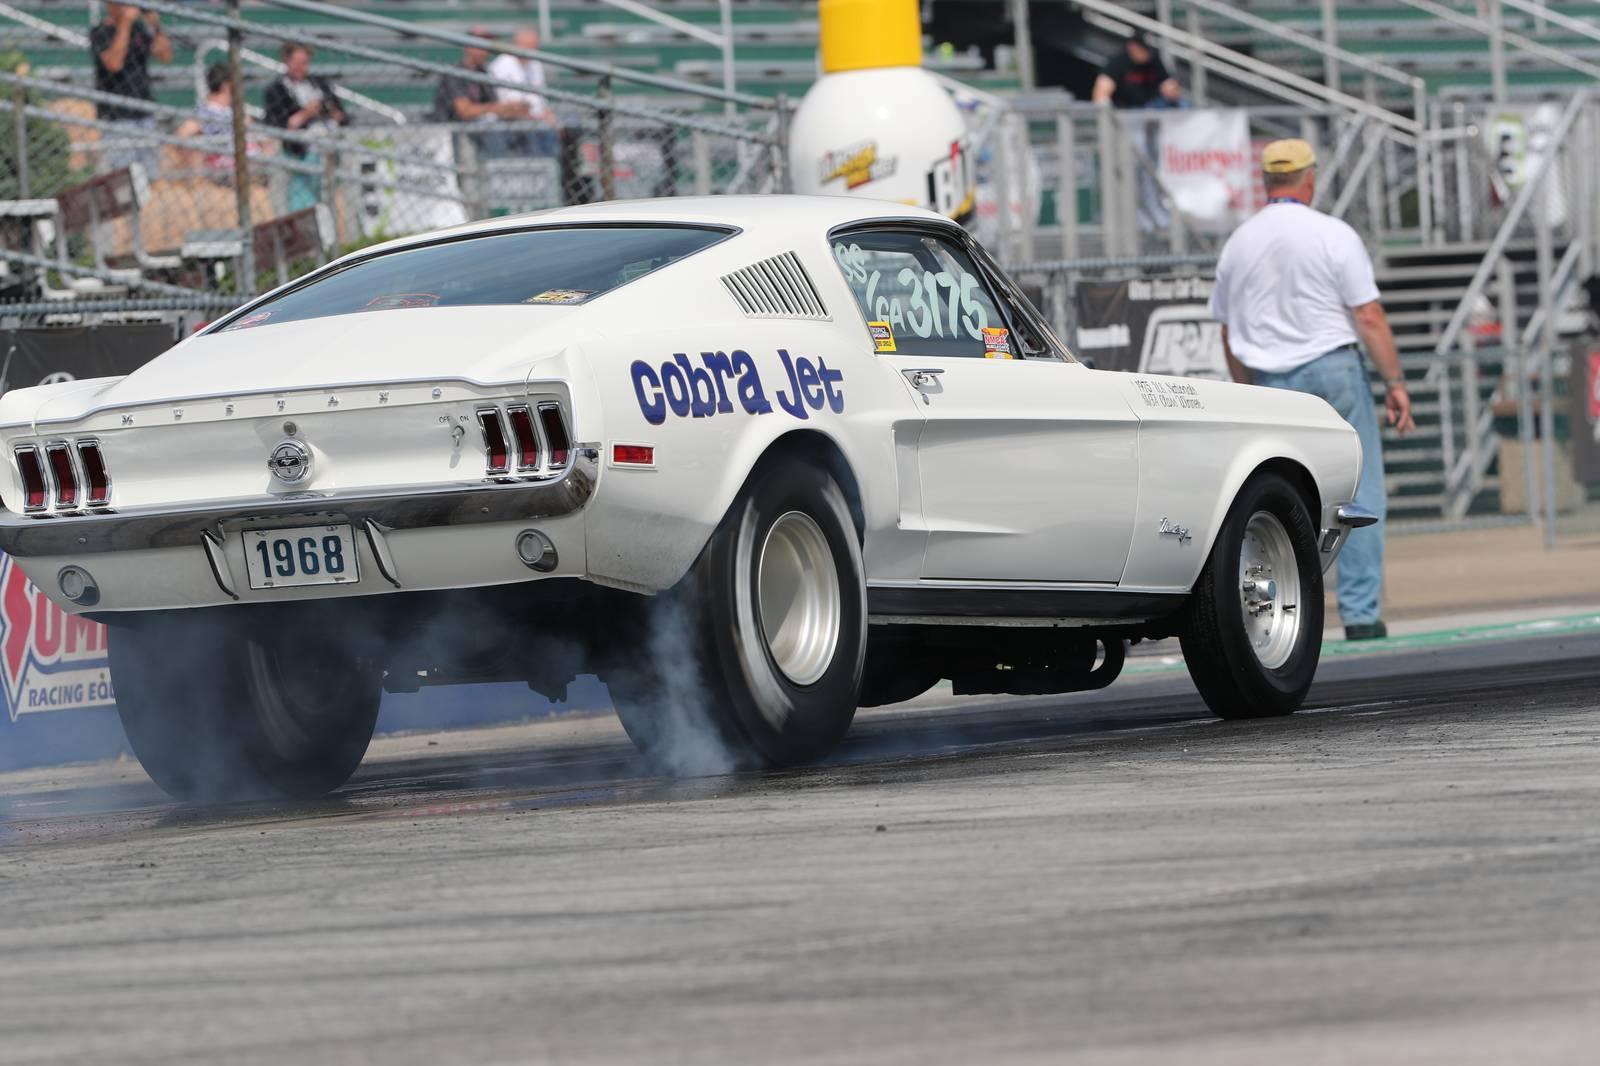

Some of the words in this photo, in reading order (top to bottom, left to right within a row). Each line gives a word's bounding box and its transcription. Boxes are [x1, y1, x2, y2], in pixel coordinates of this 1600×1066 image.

[897, 267, 988, 341] 3175
[776, 349, 845, 420] Jet
[459, 414, 470, 422] ON
[256, 535, 345, 578] 1968
[28, 684, 83, 708] RACING
